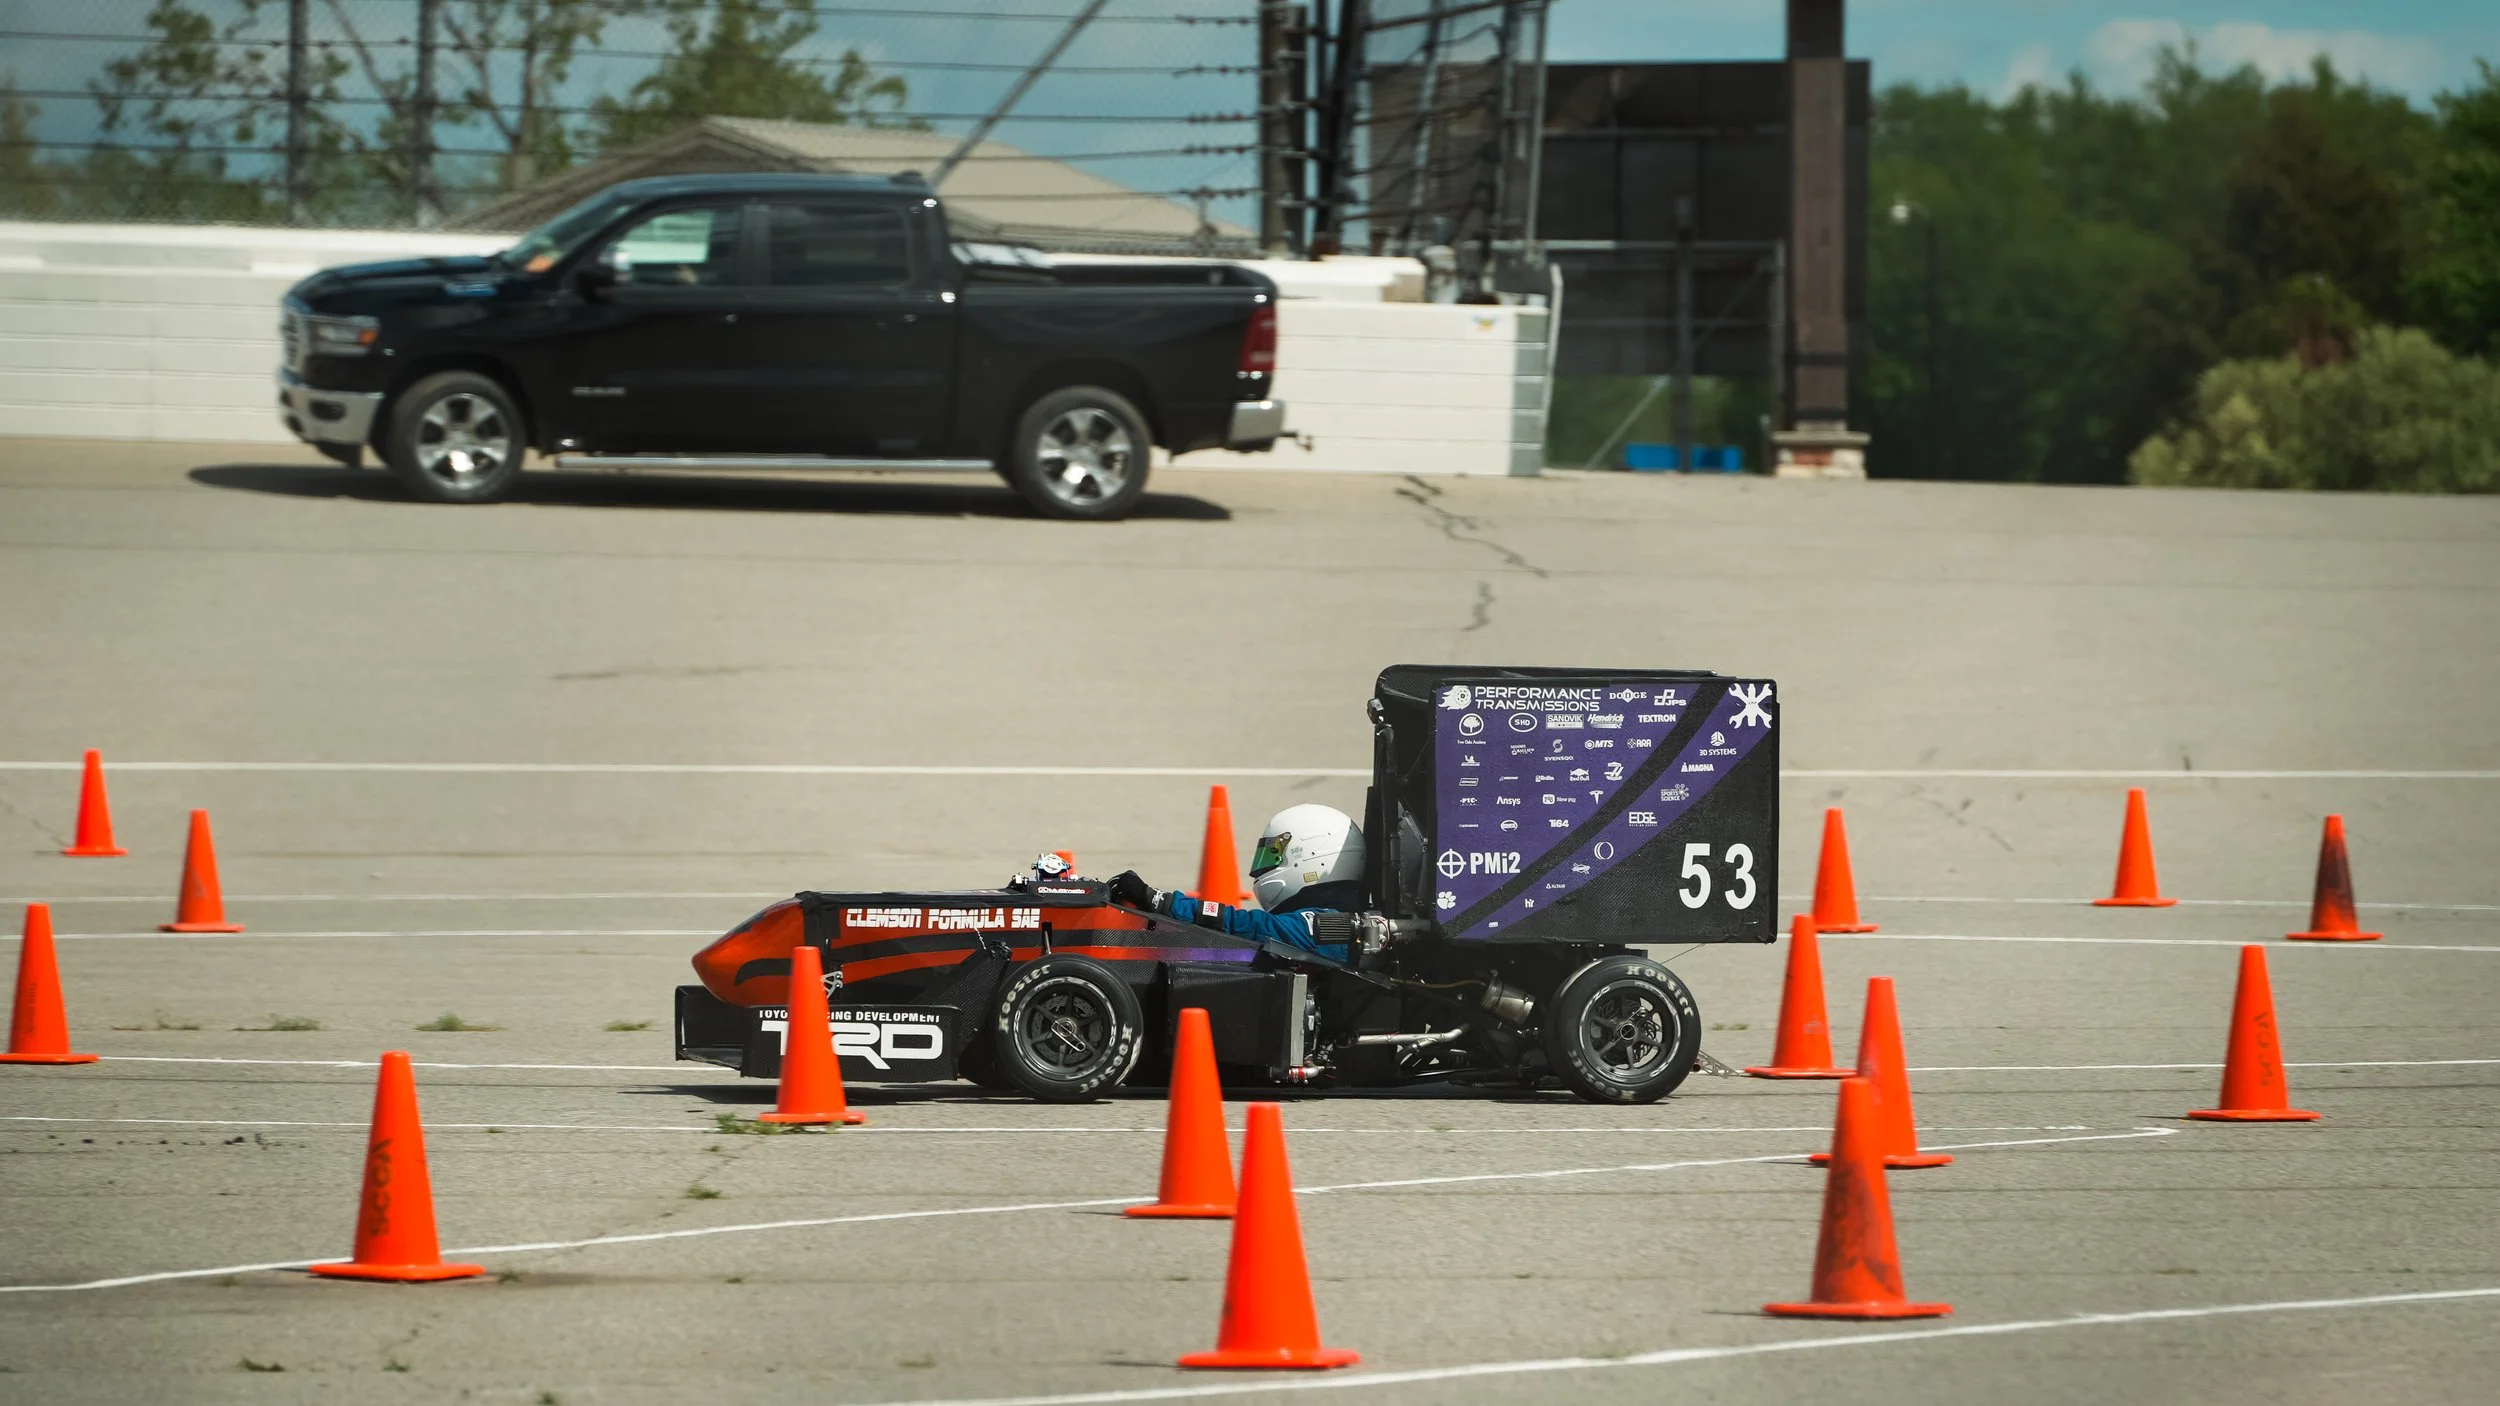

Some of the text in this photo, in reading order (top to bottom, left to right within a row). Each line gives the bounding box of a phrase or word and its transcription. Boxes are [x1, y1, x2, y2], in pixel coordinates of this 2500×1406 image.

[1609, 690, 1648, 701] DODGE
[1475, 699, 1600, 712] TRANSMISSIONS
[1547, 715, 1582, 723] SANDVIK
[1587, 713, 1624, 724] Hendrick
[1638, 714, 1676, 723] TEXTRON
[1595, 740, 1613, 748] MTS
[1688, 764, 1715, 772] MAGNA
[1496, 796, 1521, 806] Ansys
[1629, 812, 1657, 824] EDGE
[1470, 852, 1520, 874] PMi2
[846, 908, 1040, 929] CLEMSON FORMULA SAE
[1626, 965, 1694, 1018] Hoosier
[998, 963, 1051, 1034] Hoosier
[1079, 1023, 1133, 1093] Hoosier
[369, 1137, 393, 1237] SCCA
